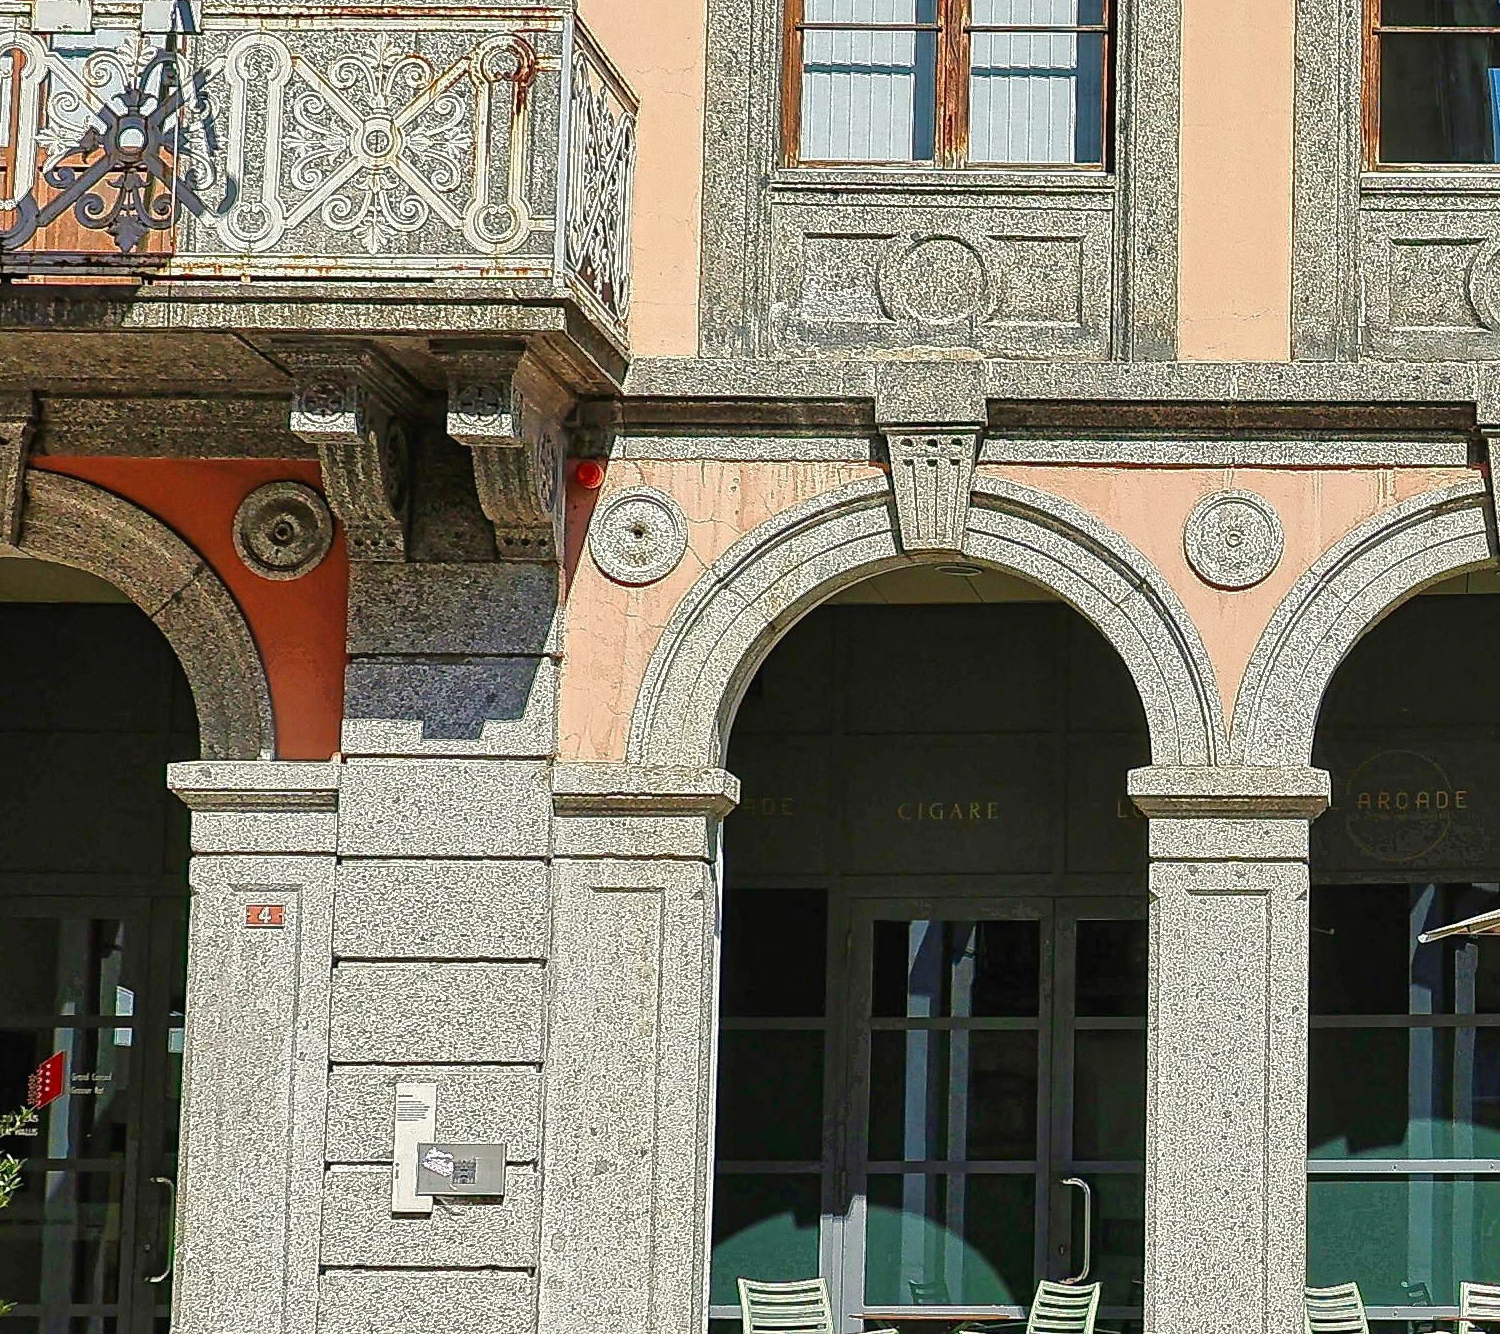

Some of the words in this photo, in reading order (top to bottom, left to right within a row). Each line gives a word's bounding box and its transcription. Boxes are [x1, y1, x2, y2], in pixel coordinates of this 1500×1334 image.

[1356, 790, 1468, 809] ARCADE
[897, 802, 999, 820] CIGARE
[258, 906, 272, 924] 4
